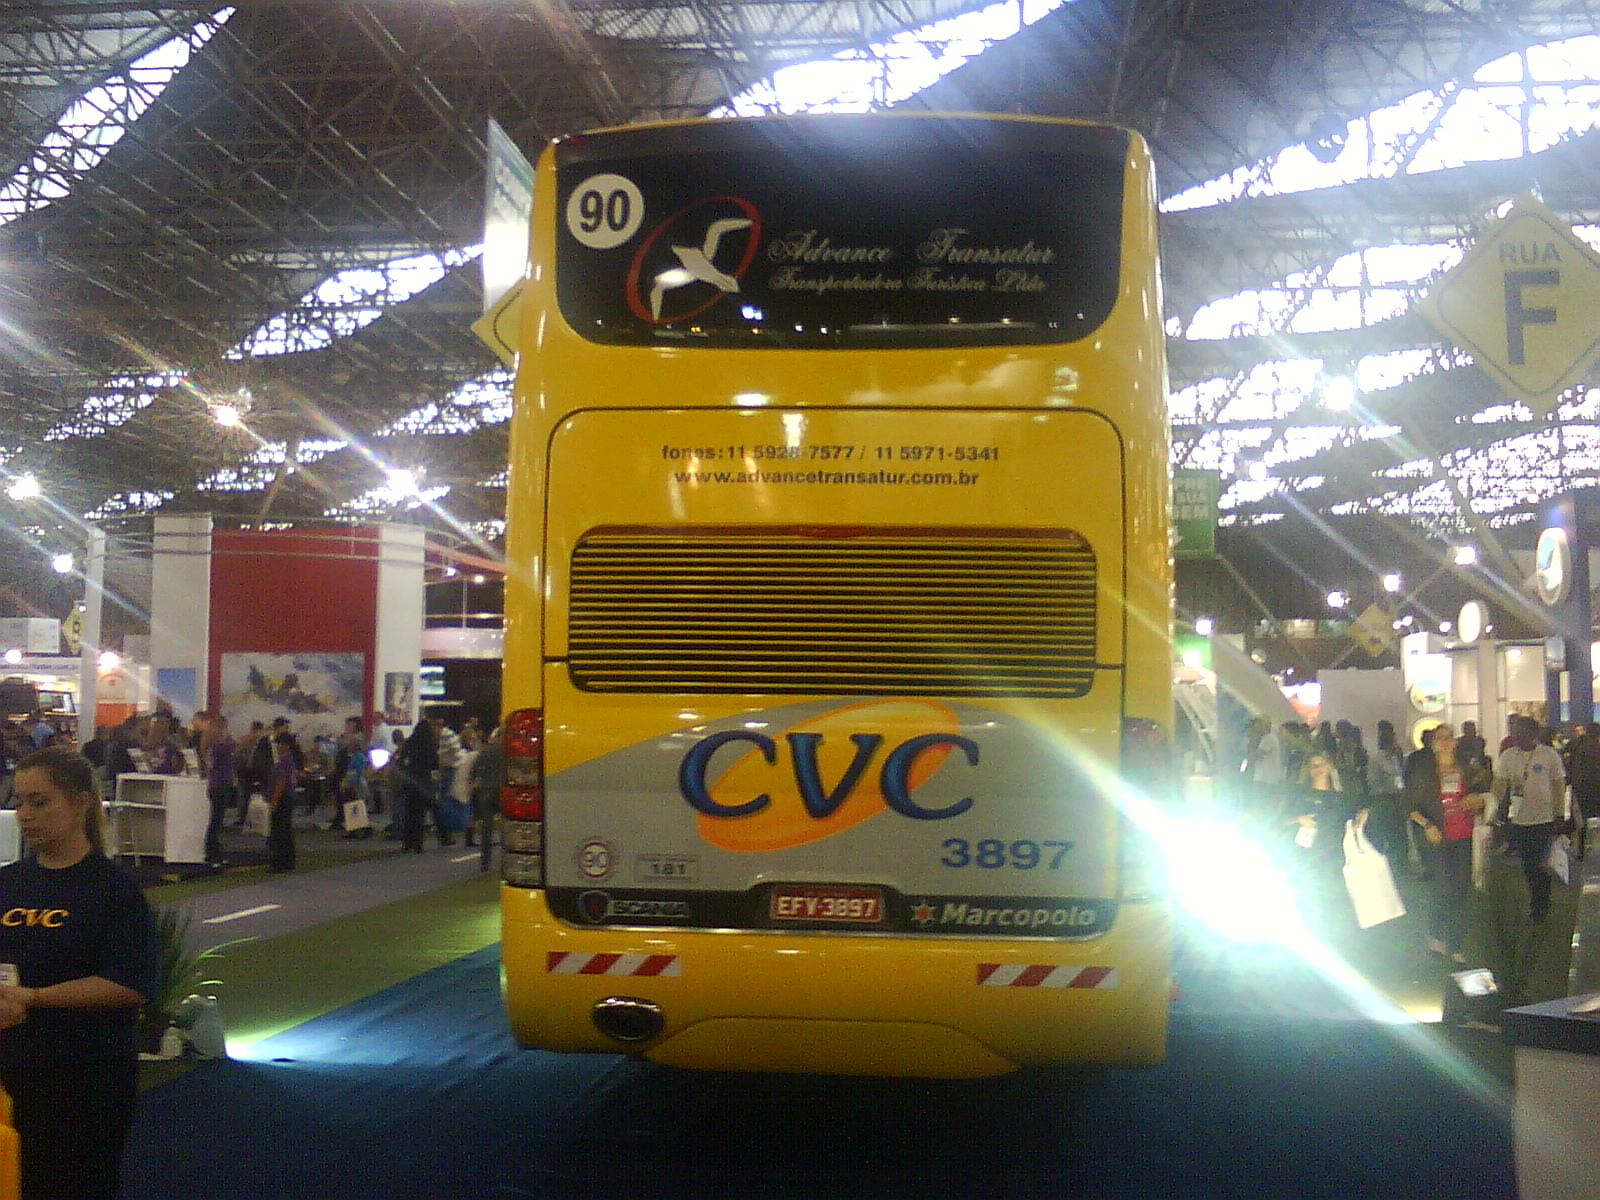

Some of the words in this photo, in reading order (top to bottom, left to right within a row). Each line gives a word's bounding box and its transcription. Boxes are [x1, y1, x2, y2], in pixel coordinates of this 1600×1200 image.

[580, 189, 631, 232] 90
[1500, 241, 1562, 264] RUA
[1504, 270, 1559, 365] F
[876, 446, 892, 460] 11
[901, 446, 999, 461] 5971-5341
[675, 470, 979, 485] www.advancetransatur.com.br
[679, 730, 980, 821] CVC
[941, 838, 1074, 870] 3897
[1, 907, 70, 928] CVC
[941, 903, 1097, 928] Marcopolo
